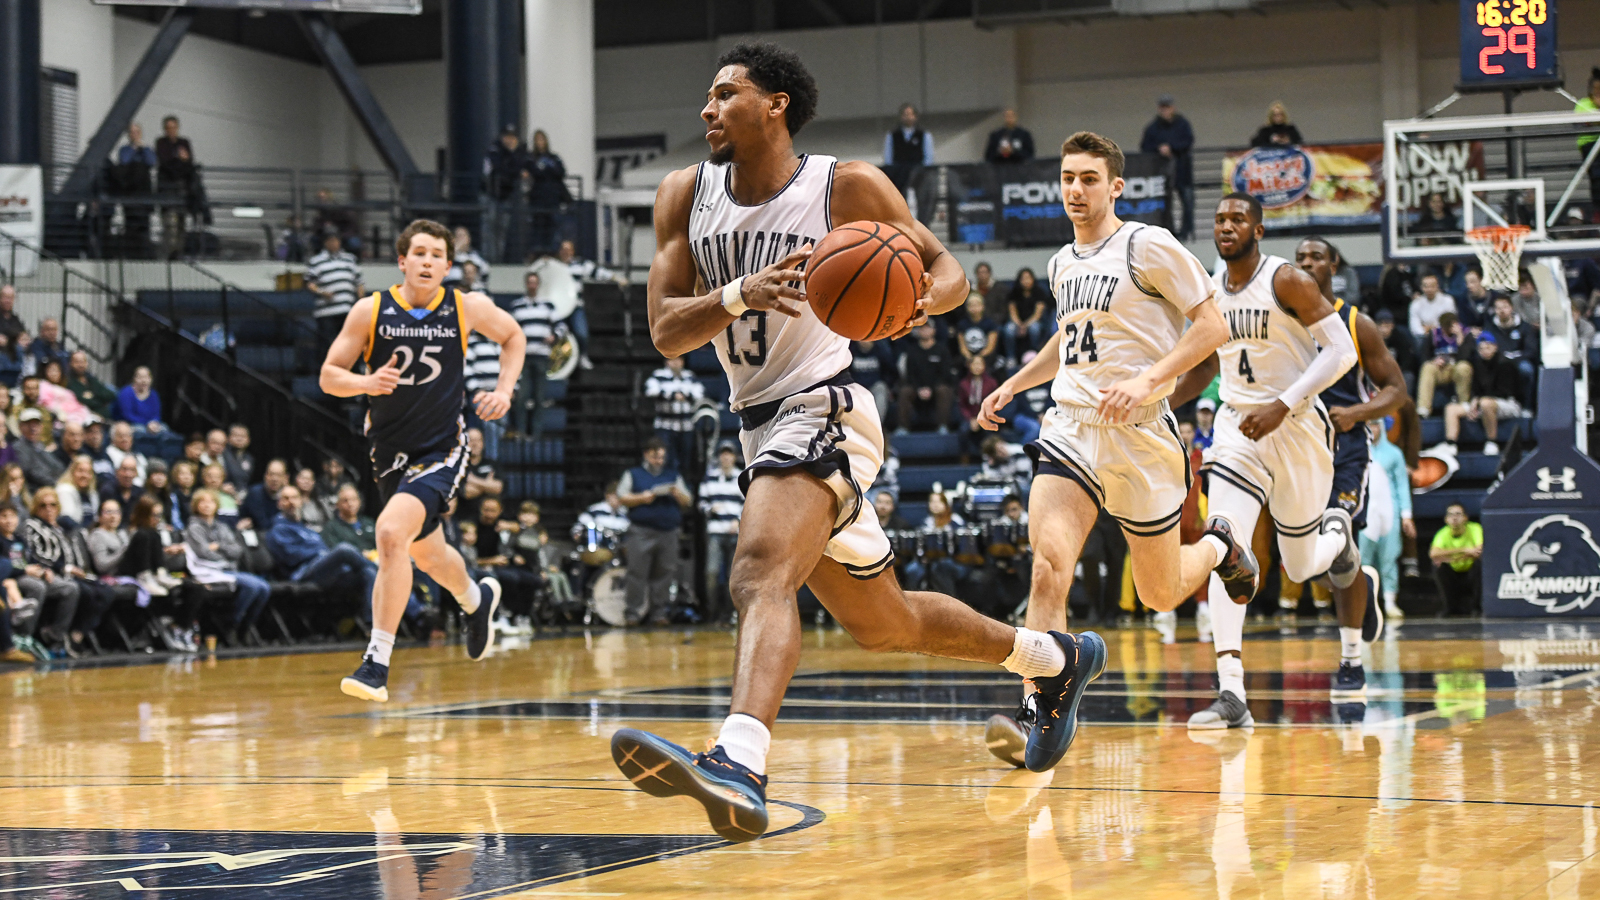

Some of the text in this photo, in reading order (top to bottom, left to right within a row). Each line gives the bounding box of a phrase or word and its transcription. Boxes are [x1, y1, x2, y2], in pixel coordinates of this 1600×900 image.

[1476, 0, 1547, 27] 16:20
[1479, 26, 1536, 75] 29
[378, 323, 458, 341] Quinnipiac
[726, 308, 767, 366] 13
[1065, 320, 1098, 365] 24
[1223, 308, 1270, 342] MOUTH
[393, 345, 444, 386] 25
[1238, 348, 1256, 384] 4
[1502, 575, 1600, 595] MONMOUT
